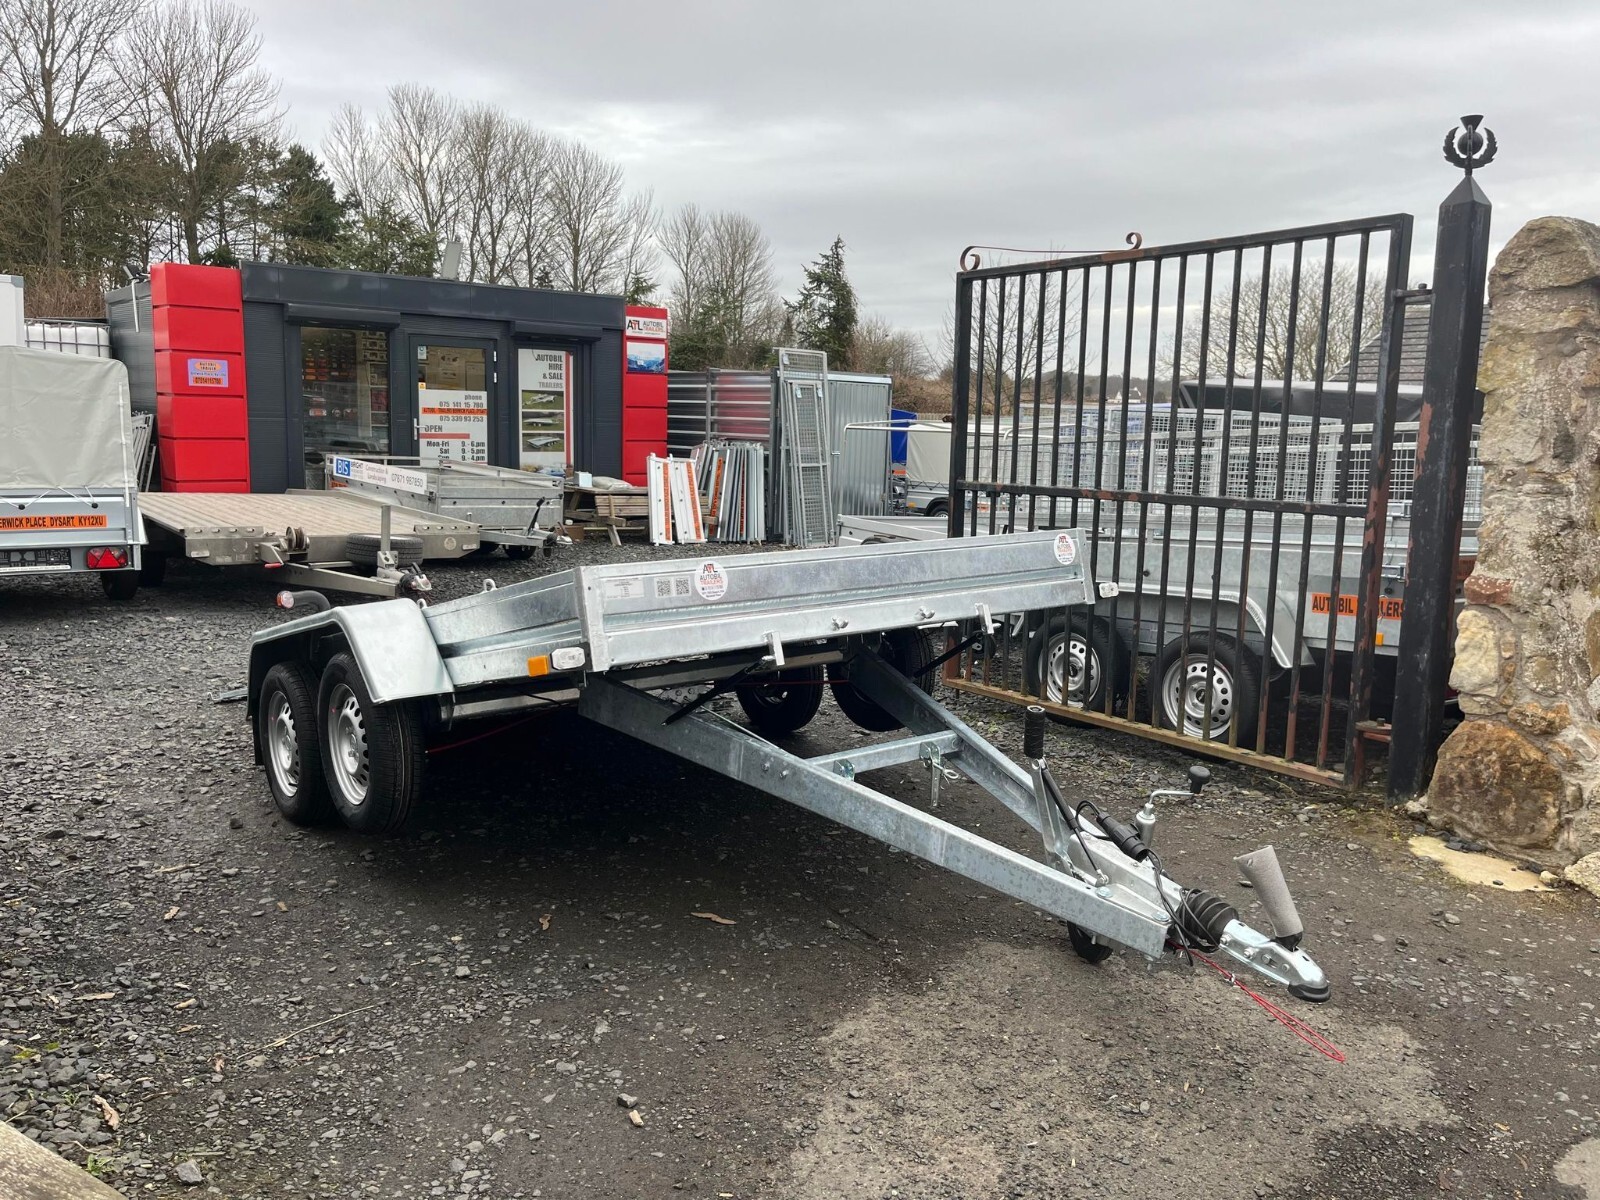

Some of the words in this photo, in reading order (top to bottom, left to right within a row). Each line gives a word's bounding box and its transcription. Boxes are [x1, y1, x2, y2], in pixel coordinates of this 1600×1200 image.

[627, 320, 643, 331] ATL
[536, 354, 563, 362] AUTOBIL
[548, 363, 563, 371] HIRE
[548, 372, 563, 380] SALE
[538, 381, 563, 389] TRAILERS
[424, 425, 443, 433] OPEN
[337, 460, 349, 475] BIS
[0, 517, 23, 528] ERWICK
[79, 515, 104, 525] KY12XU
[703, 563, 718, 574] ATL
[1312, 596, 1353, 613] AUTBIL
